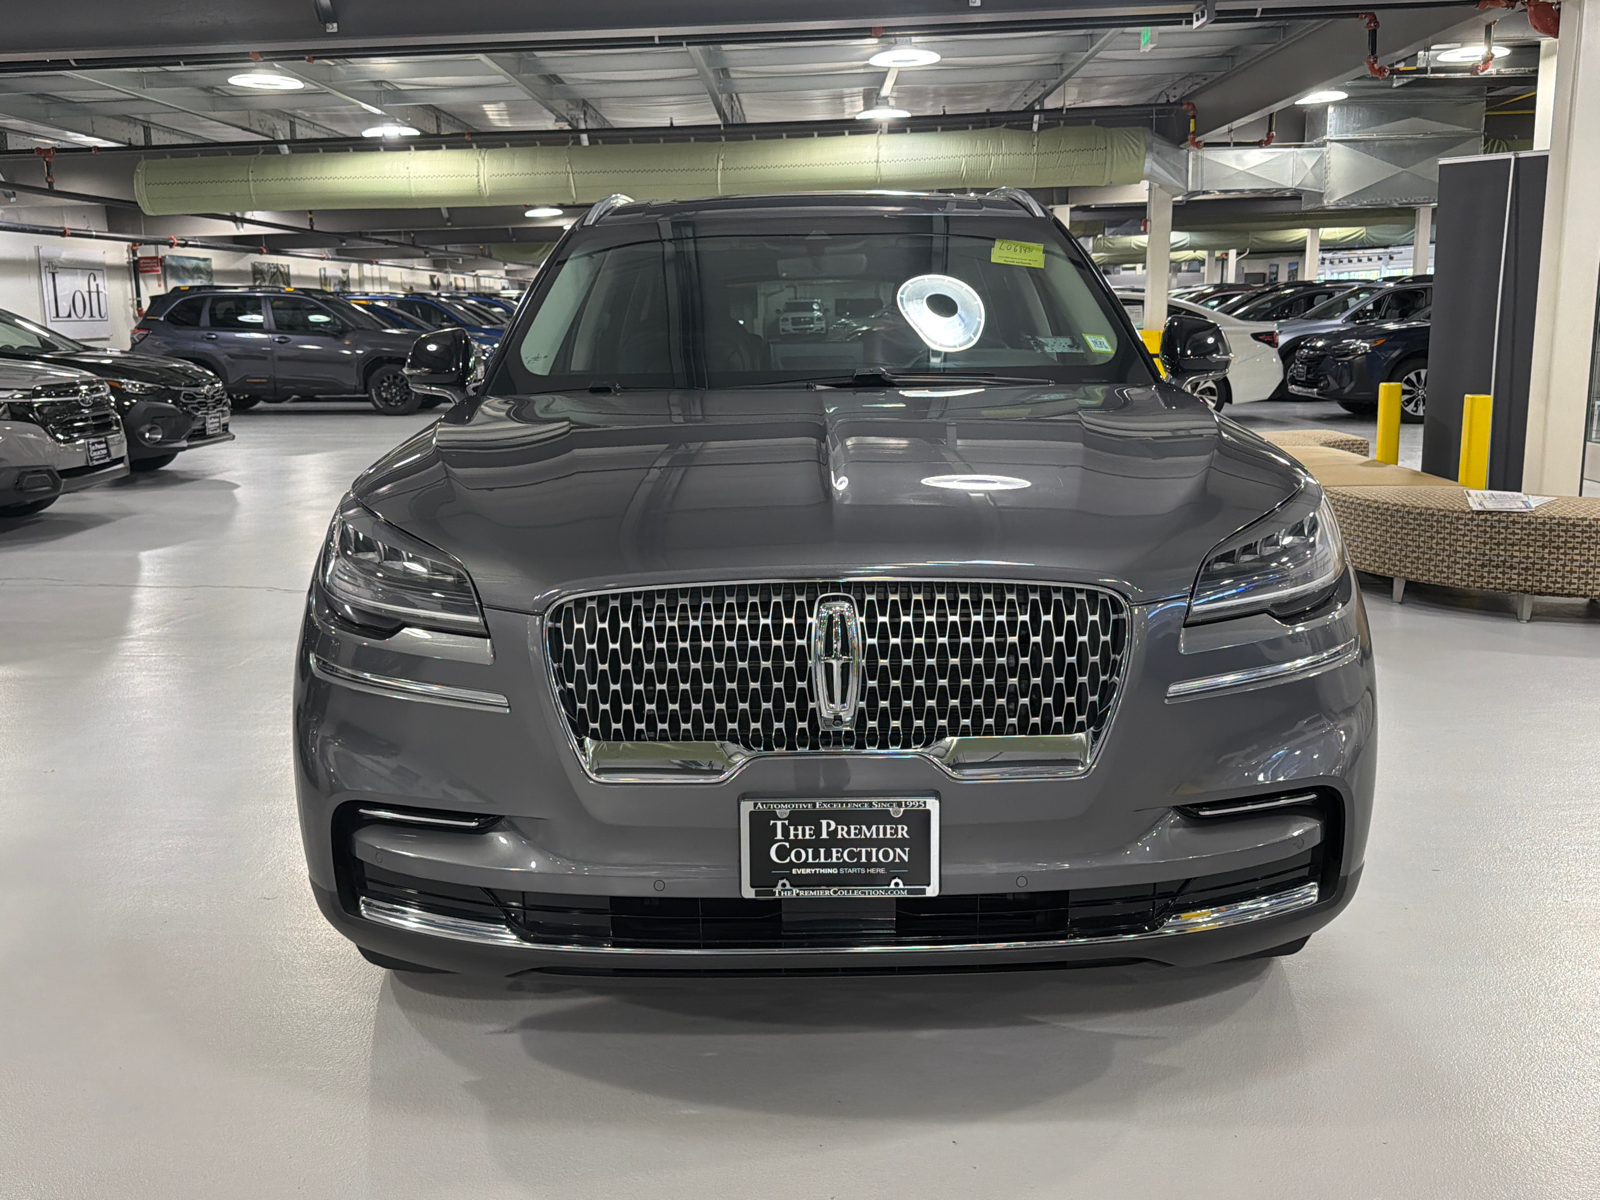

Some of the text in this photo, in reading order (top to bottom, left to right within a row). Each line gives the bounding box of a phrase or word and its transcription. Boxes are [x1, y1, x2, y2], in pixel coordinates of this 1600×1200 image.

[49, 271, 107, 319] Loft
[755, 800, 925, 810] AUTOMOTIVE EXCELLENCE SINCE 1995
[769, 819, 910, 840] THE PREMIER
[769, 842, 910, 864] COLLECTION
